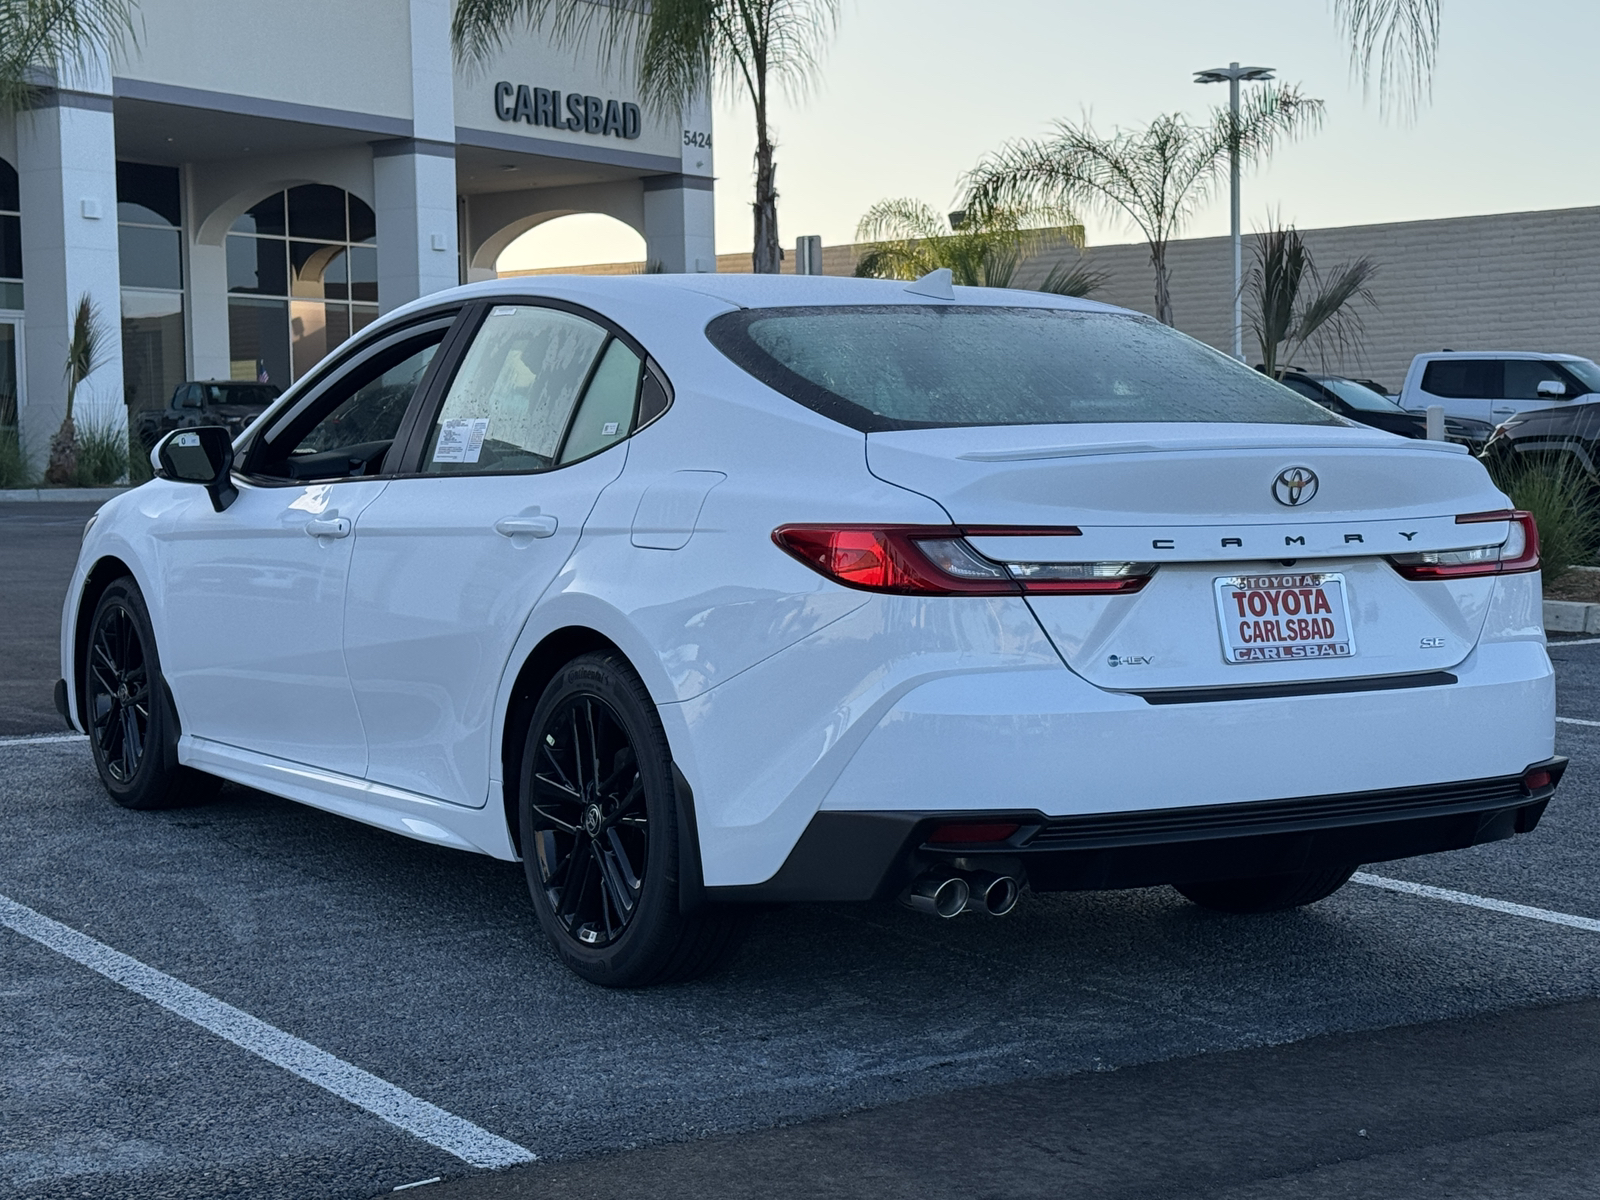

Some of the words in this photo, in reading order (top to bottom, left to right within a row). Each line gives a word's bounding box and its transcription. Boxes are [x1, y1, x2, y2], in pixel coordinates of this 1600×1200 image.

[495, 81, 641, 139] CARLSBAD
[683, 130, 712, 149] 5424
[1152, 531, 1418, 549] CAMRY
[1248, 576, 1314, 588] TOYOTA
[1232, 589, 1332, 617] TOYOTA
[1239, 618, 1335, 643] CARLSBAD
[1235, 643, 1349, 661] CARLSBAD
[1420, 637, 1446, 649] SE
